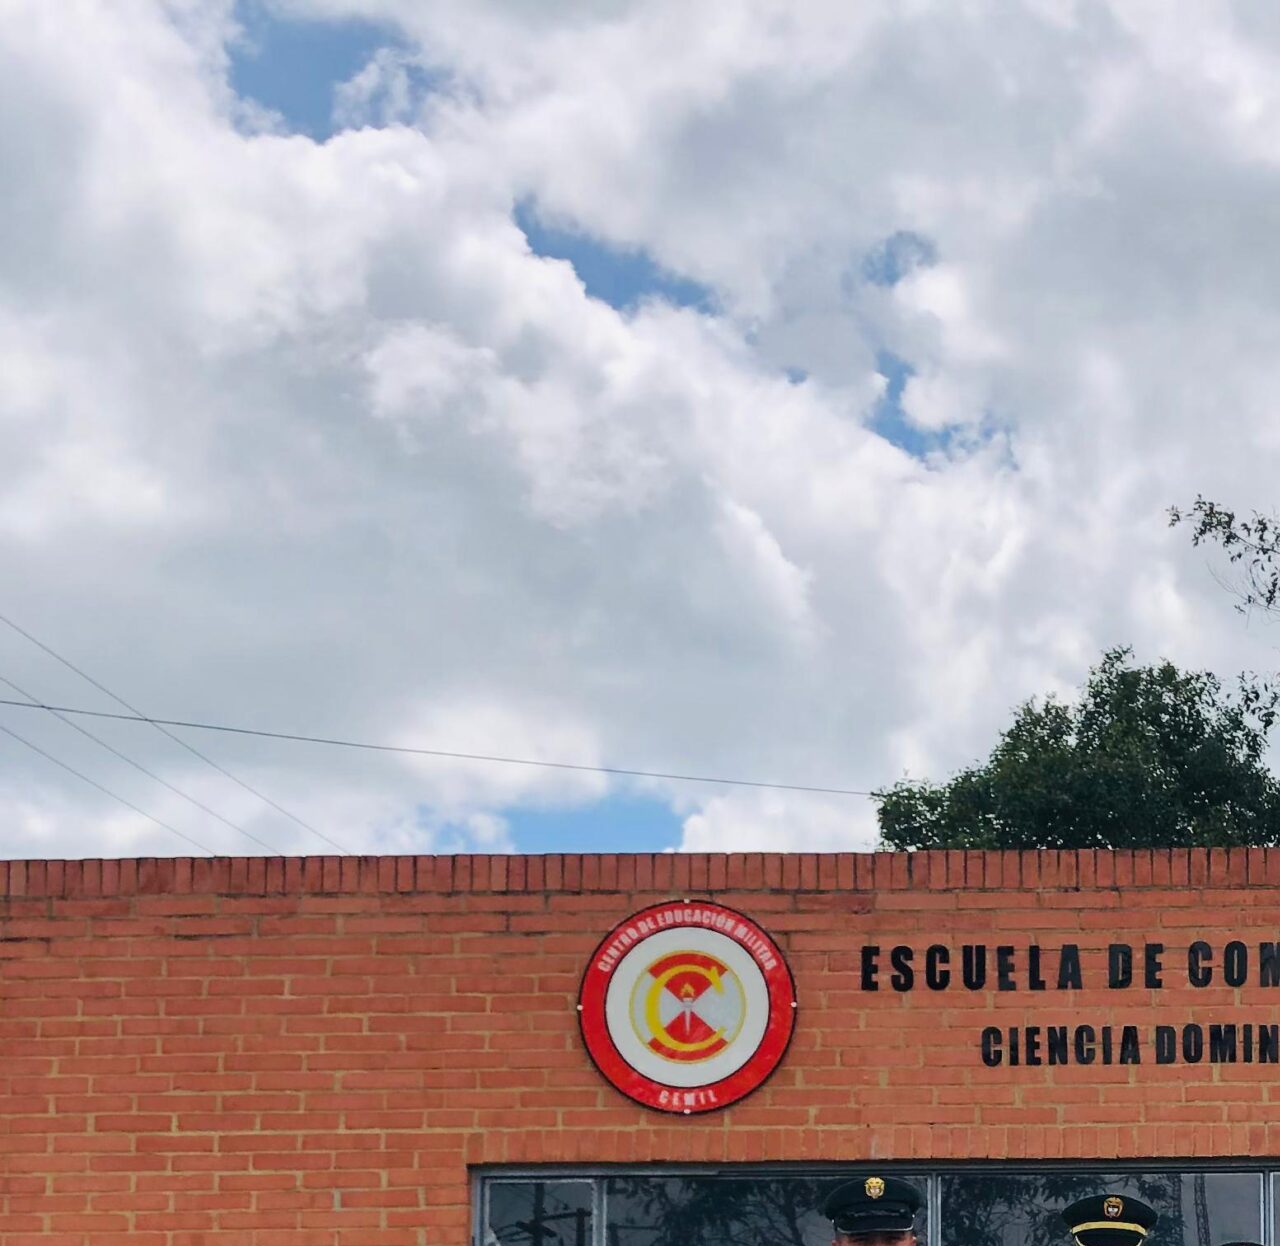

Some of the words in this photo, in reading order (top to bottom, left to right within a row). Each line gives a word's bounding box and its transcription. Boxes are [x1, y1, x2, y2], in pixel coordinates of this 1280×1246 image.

[597, 928, 639, 972] CENTRO
[639, 917, 657, 935] DE
[734, 924, 777, 971] MILITAR
[860, 944, 1083, 992] ESCUELA
[1108, 943, 1164, 989] DE
[981, 1024, 1141, 1067] CIENCIA
[659, 1090, 718, 1106] CEMIL
